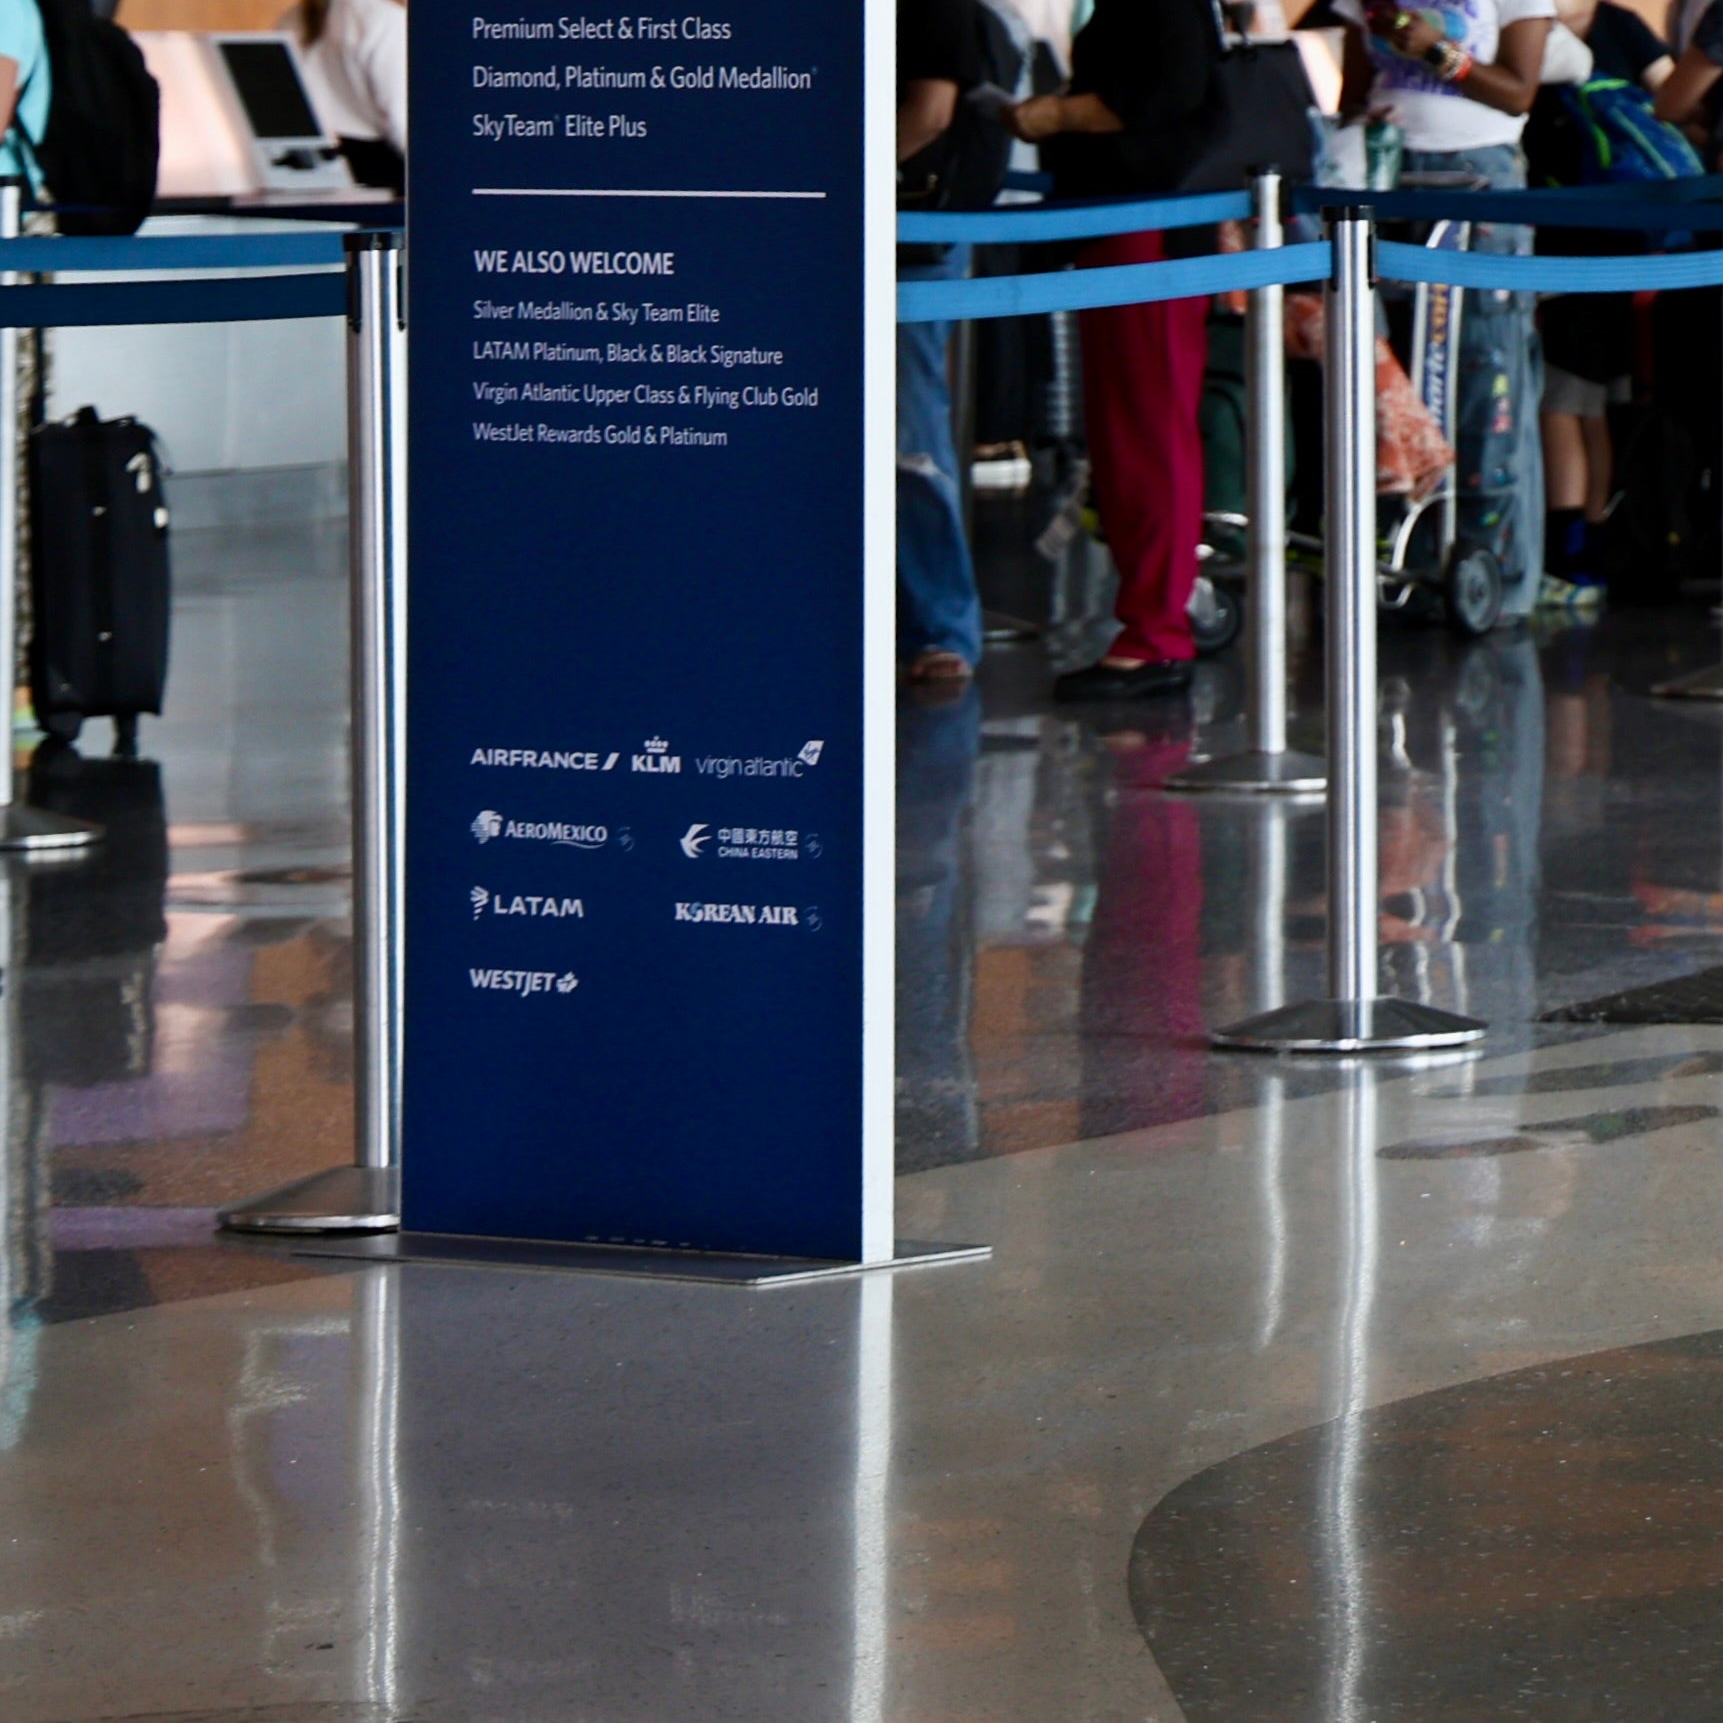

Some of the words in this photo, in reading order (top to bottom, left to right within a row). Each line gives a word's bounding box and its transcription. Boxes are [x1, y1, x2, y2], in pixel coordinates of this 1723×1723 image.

[473, 17, 554, 39] Premium
[559, 17, 614, 39] Select
[618, 17, 633, 39] &
[638, 17, 677, 39] First
[682, 17, 731, 39] Class
[473, 66, 560, 90] Diamond,
[566, 65, 646, 88] Platinum
[650, 66, 666, 88] &
[670, 66, 713, 88] Gold
[566, 114, 604, 137] Elite
[609, 114, 647, 137] Plus
[474, 250, 508, 272] WE
[511, 251, 565, 273] ALSO
[570, 252, 674, 274] WELCOME
[474, 300, 515, 319] Silver
[518, 301, 593, 320] Medallion
[596, 302, 608, 320] &
[612, 302, 639, 325] Sky
[642, 303, 683, 321] Team
[687, 303, 720, 322] Elite
[474, 341, 529, 360] LATAM
[533, 342, 603, 363] Platinum,
[607, 343, 647, 362] Black
[650, 344, 663, 362] &
[667, 344, 707, 363] Black
[711, 345, 783, 368] Signature
[473, 382, 518, 405] Virgin
[521, 383, 580, 402] Atlantic
[583, 384, 631, 406] Upper
[634, 384, 675, 404] Class
[678, 385, 691, 404] &
[694, 386, 739, 409] Flying
[742, 386, 778, 406] Club
[781, 387, 818, 406] Gold
[473, 422, 534, 441] WestJet
[537, 423, 601, 443] Rewards
[604, 425, 640, 444] Gold
[644, 426, 657, 444] &
[660, 426, 727, 445] Platinum
[631, 754, 683, 774] KLM
[717, 846, 750, 858] CHINA
[751, 848, 799, 860] EASTERN
[494, 895, 583, 918] LATAM
[675, 903, 755, 924] KOREAN
[758, 906, 798, 925] AIR
[470, 969, 557, 997] WESTJET
